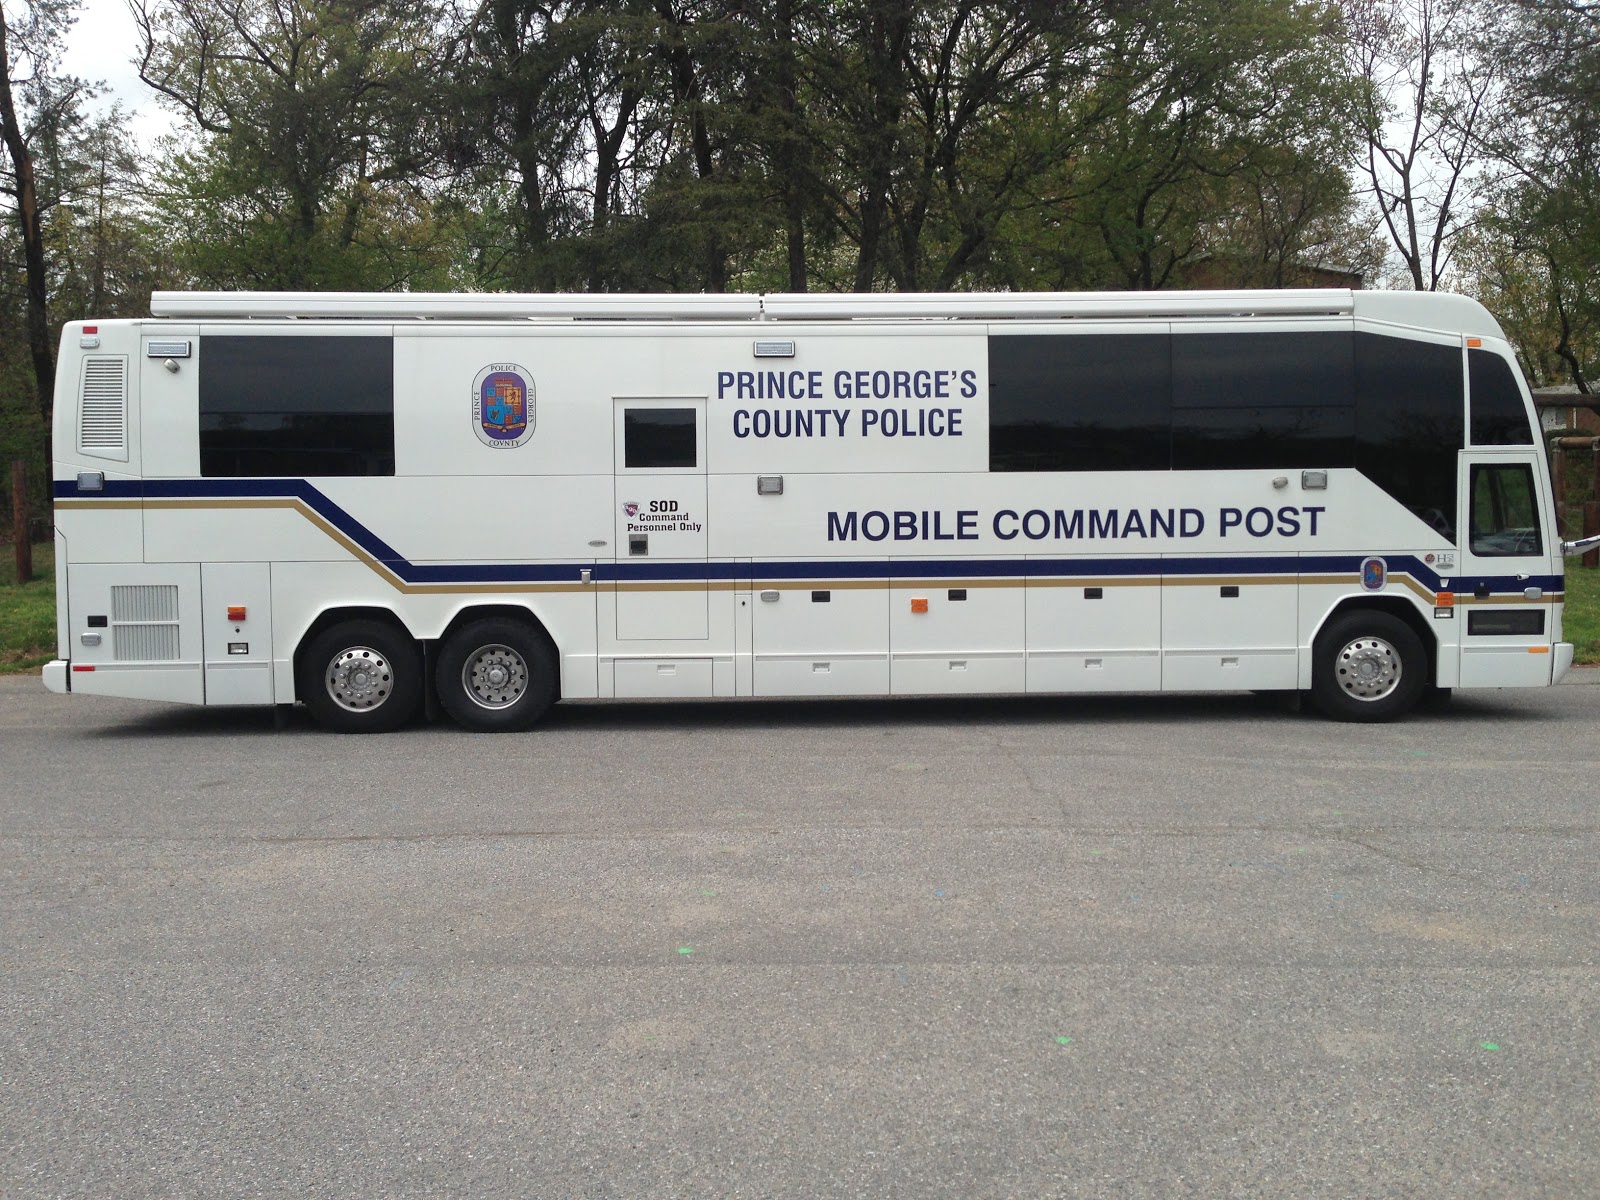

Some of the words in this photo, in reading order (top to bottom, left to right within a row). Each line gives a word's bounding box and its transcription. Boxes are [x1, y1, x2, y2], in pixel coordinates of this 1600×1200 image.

[718, 371, 823, 399] PRINCE
[834, 370, 977, 399] GEORGE'S
[527, 388, 535, 424] GEORGES
[733, 409, 850, 438] COUNTY
[861, 408, 963, 437] POLICE
[639, 513, 689, 521] Command
[649, 500, 679, 512] SOD
[627, 523, 676, 531] Personnel
[679, 522, 702, 532] Only
[827, 510, 979, 542] MOBILE
[992, 508, 1205, 540] COMMAND
[1219, 506, 1326, 537] POST
